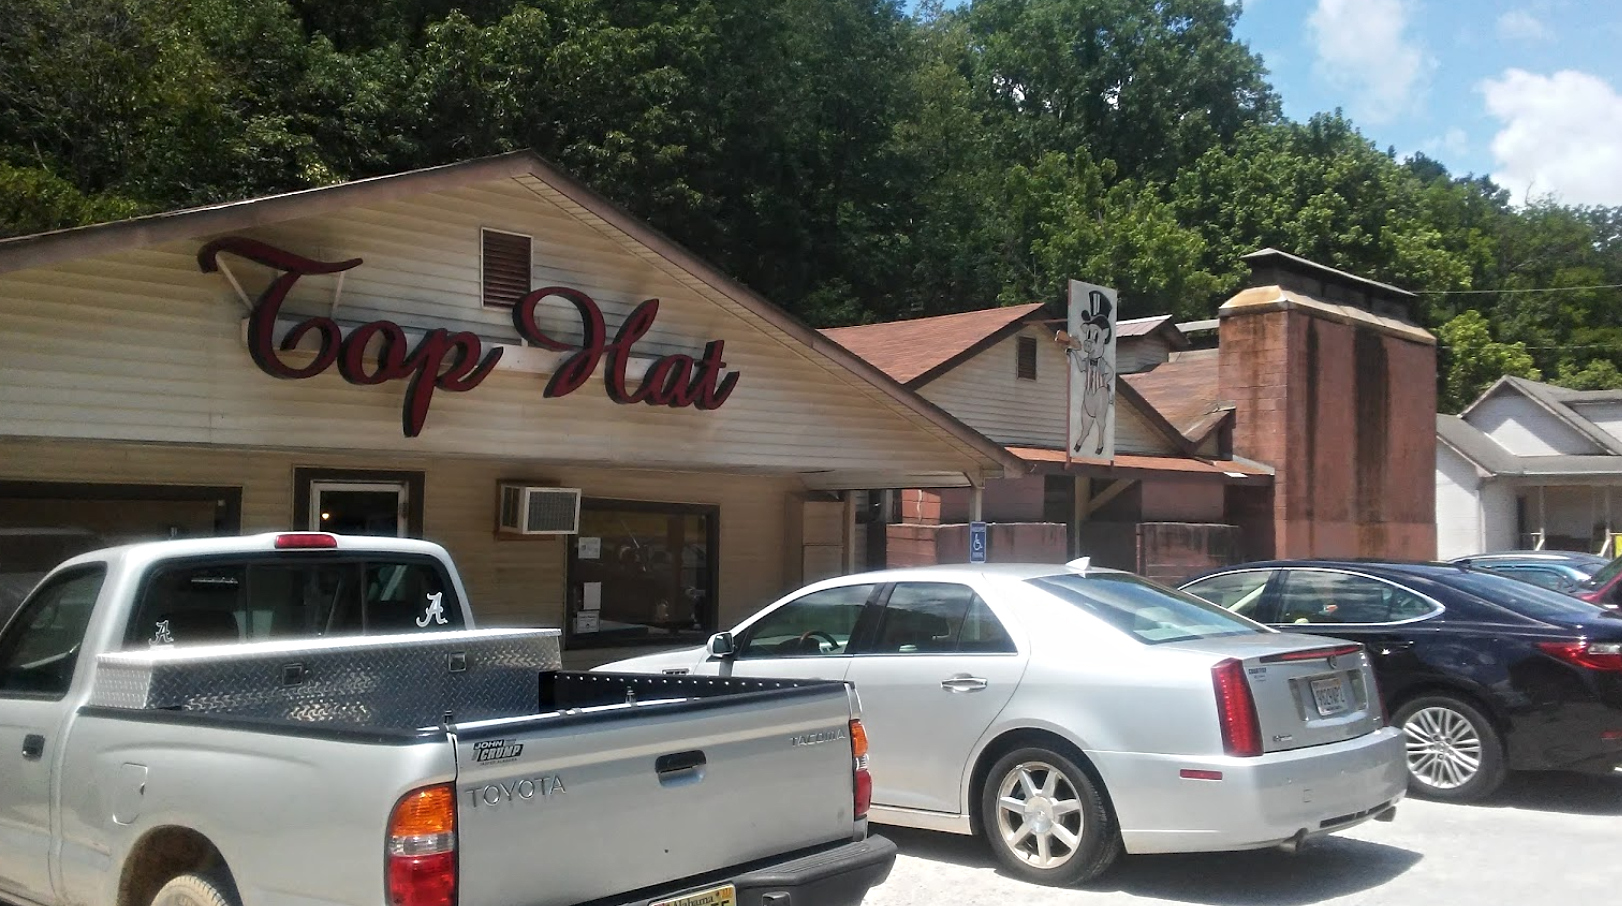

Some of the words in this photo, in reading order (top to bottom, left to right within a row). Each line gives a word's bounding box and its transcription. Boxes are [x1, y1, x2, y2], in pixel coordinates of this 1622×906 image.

[197, 236, 504, 438] Top
[512, 285, 741, 411] Hat
[416, 592, 448, 628] A
[149, 620, 174, 645] A
[474, 740, 503, 750] JOHN
[789, 729, 847, 747] TACOMA
[480, 745, 521, 761] CRUMP
[464, 774, 567, 808] TOYOTA
